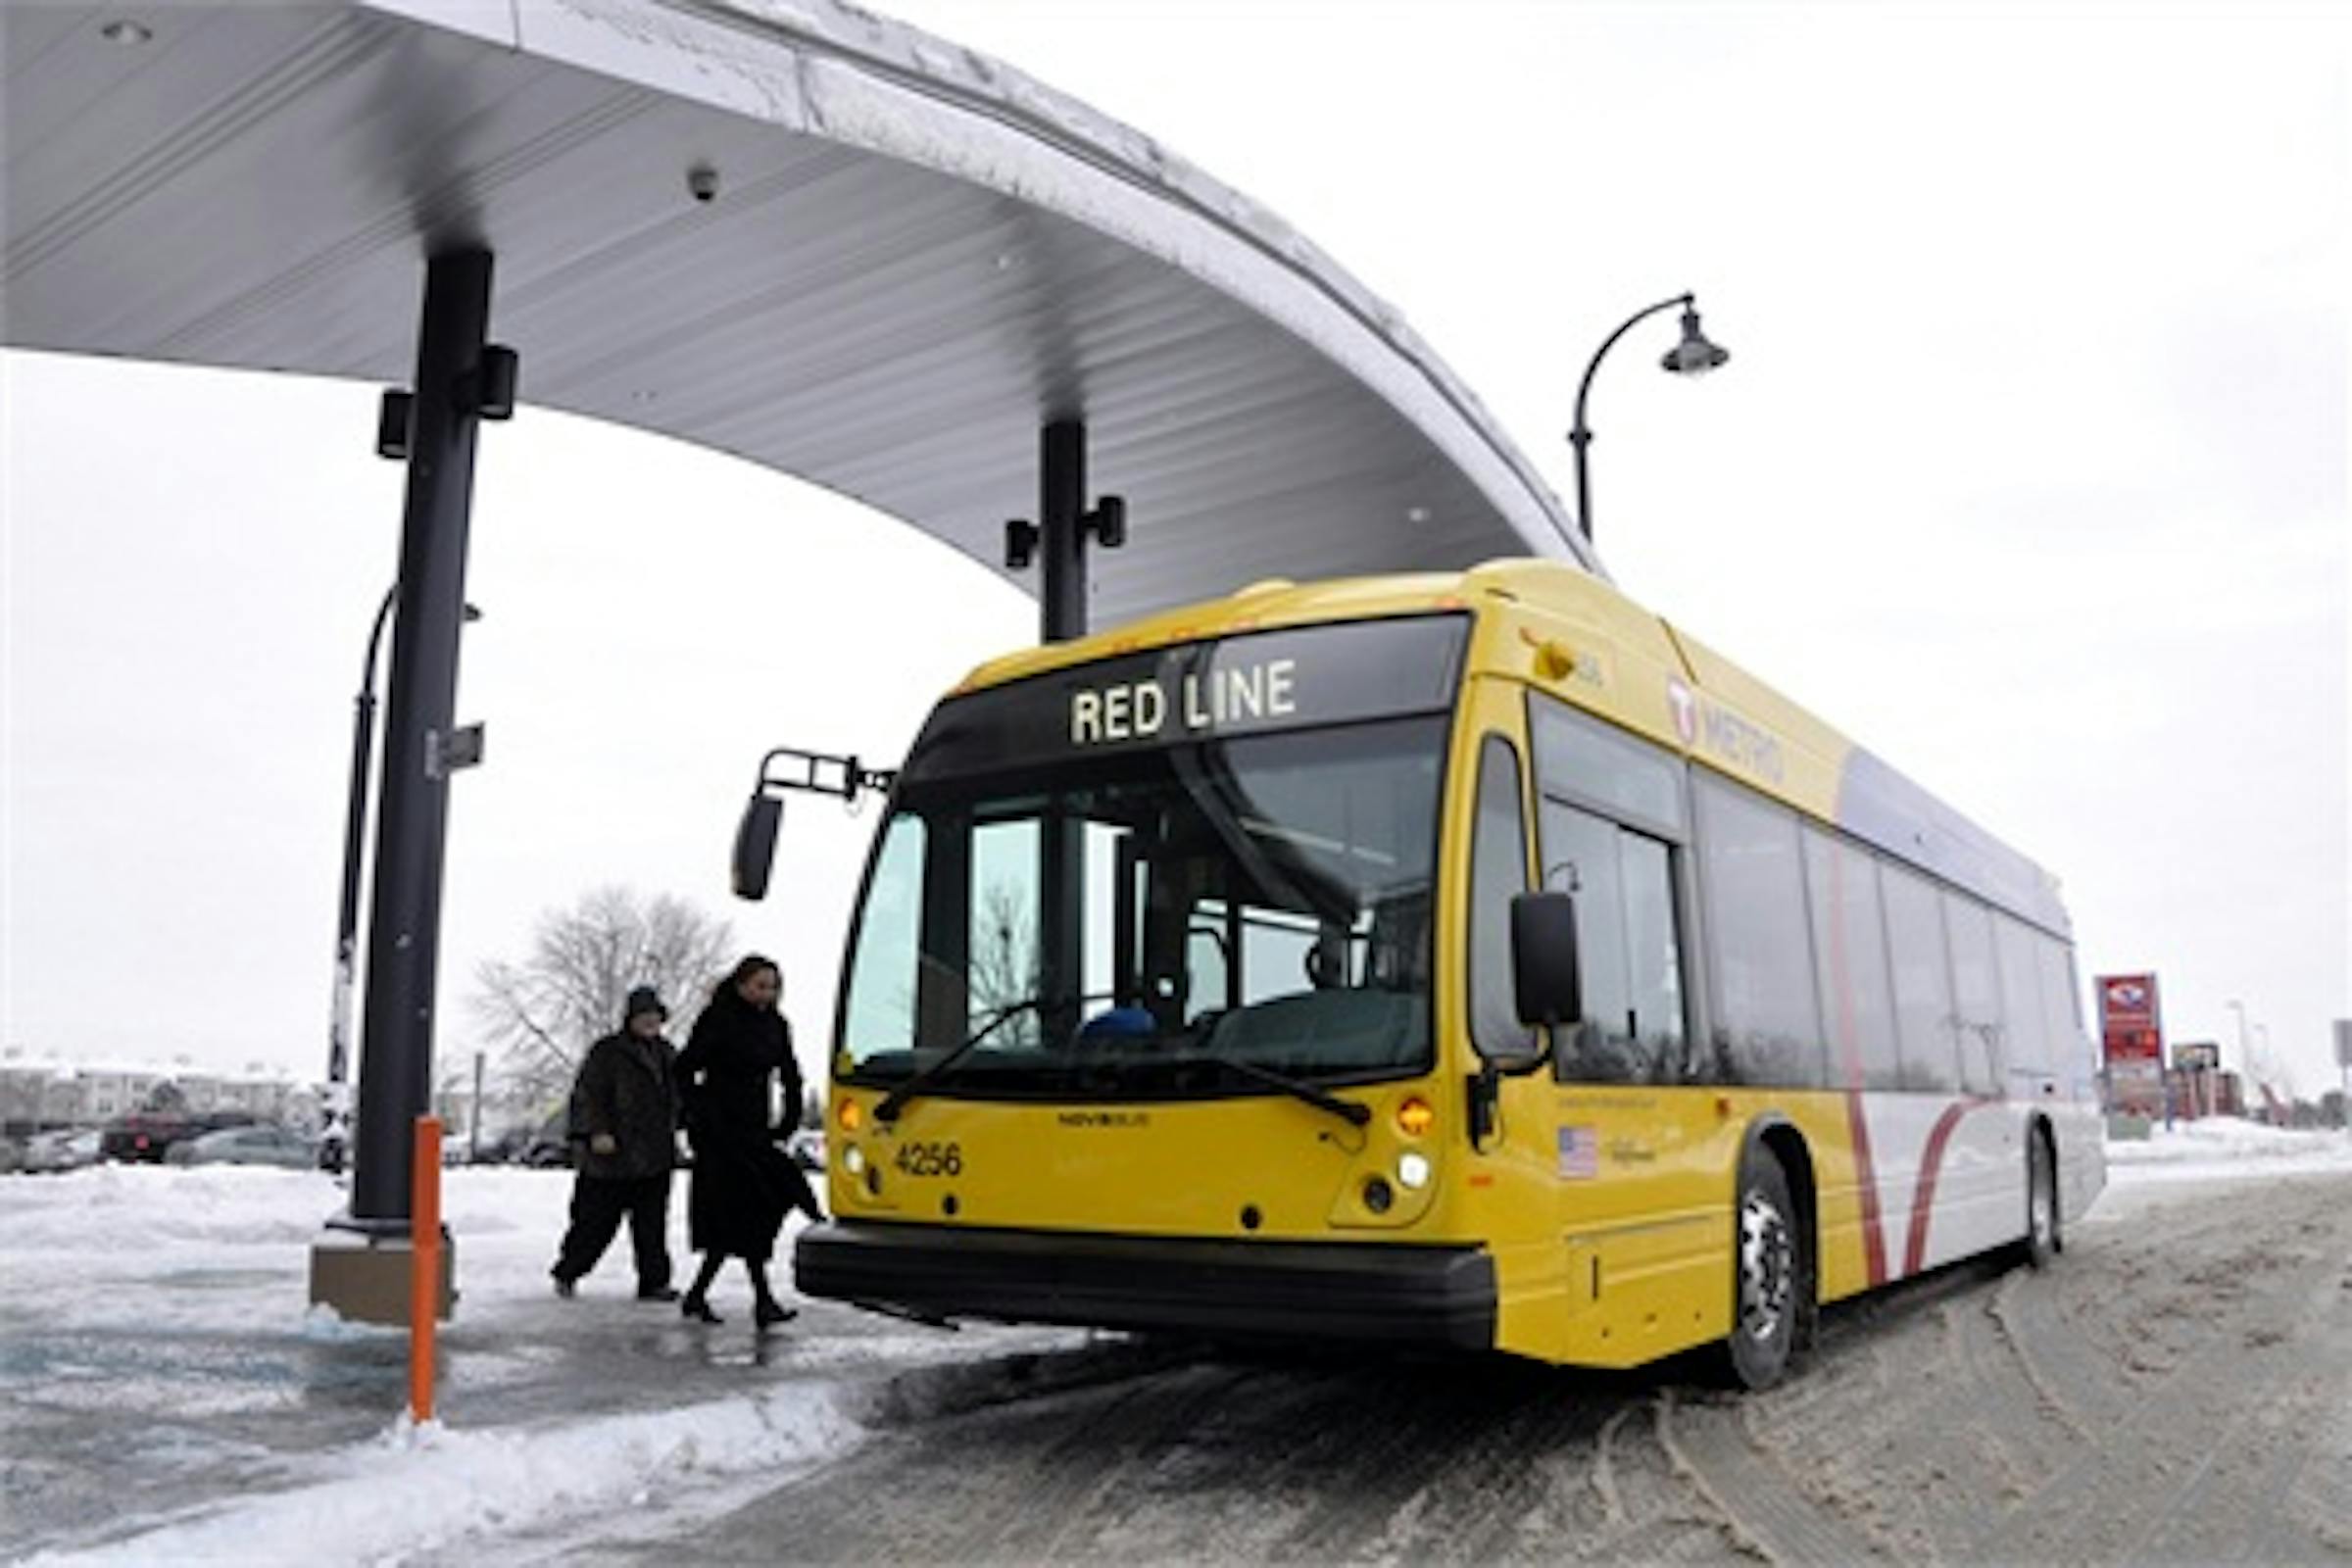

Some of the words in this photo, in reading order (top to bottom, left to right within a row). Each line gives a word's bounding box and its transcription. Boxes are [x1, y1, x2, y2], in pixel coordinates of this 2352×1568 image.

[1071, 678, 1166, 743] RED
[1184, 659, 1296, 729] LINE
[894, 1142, 962, 1176] 4256
